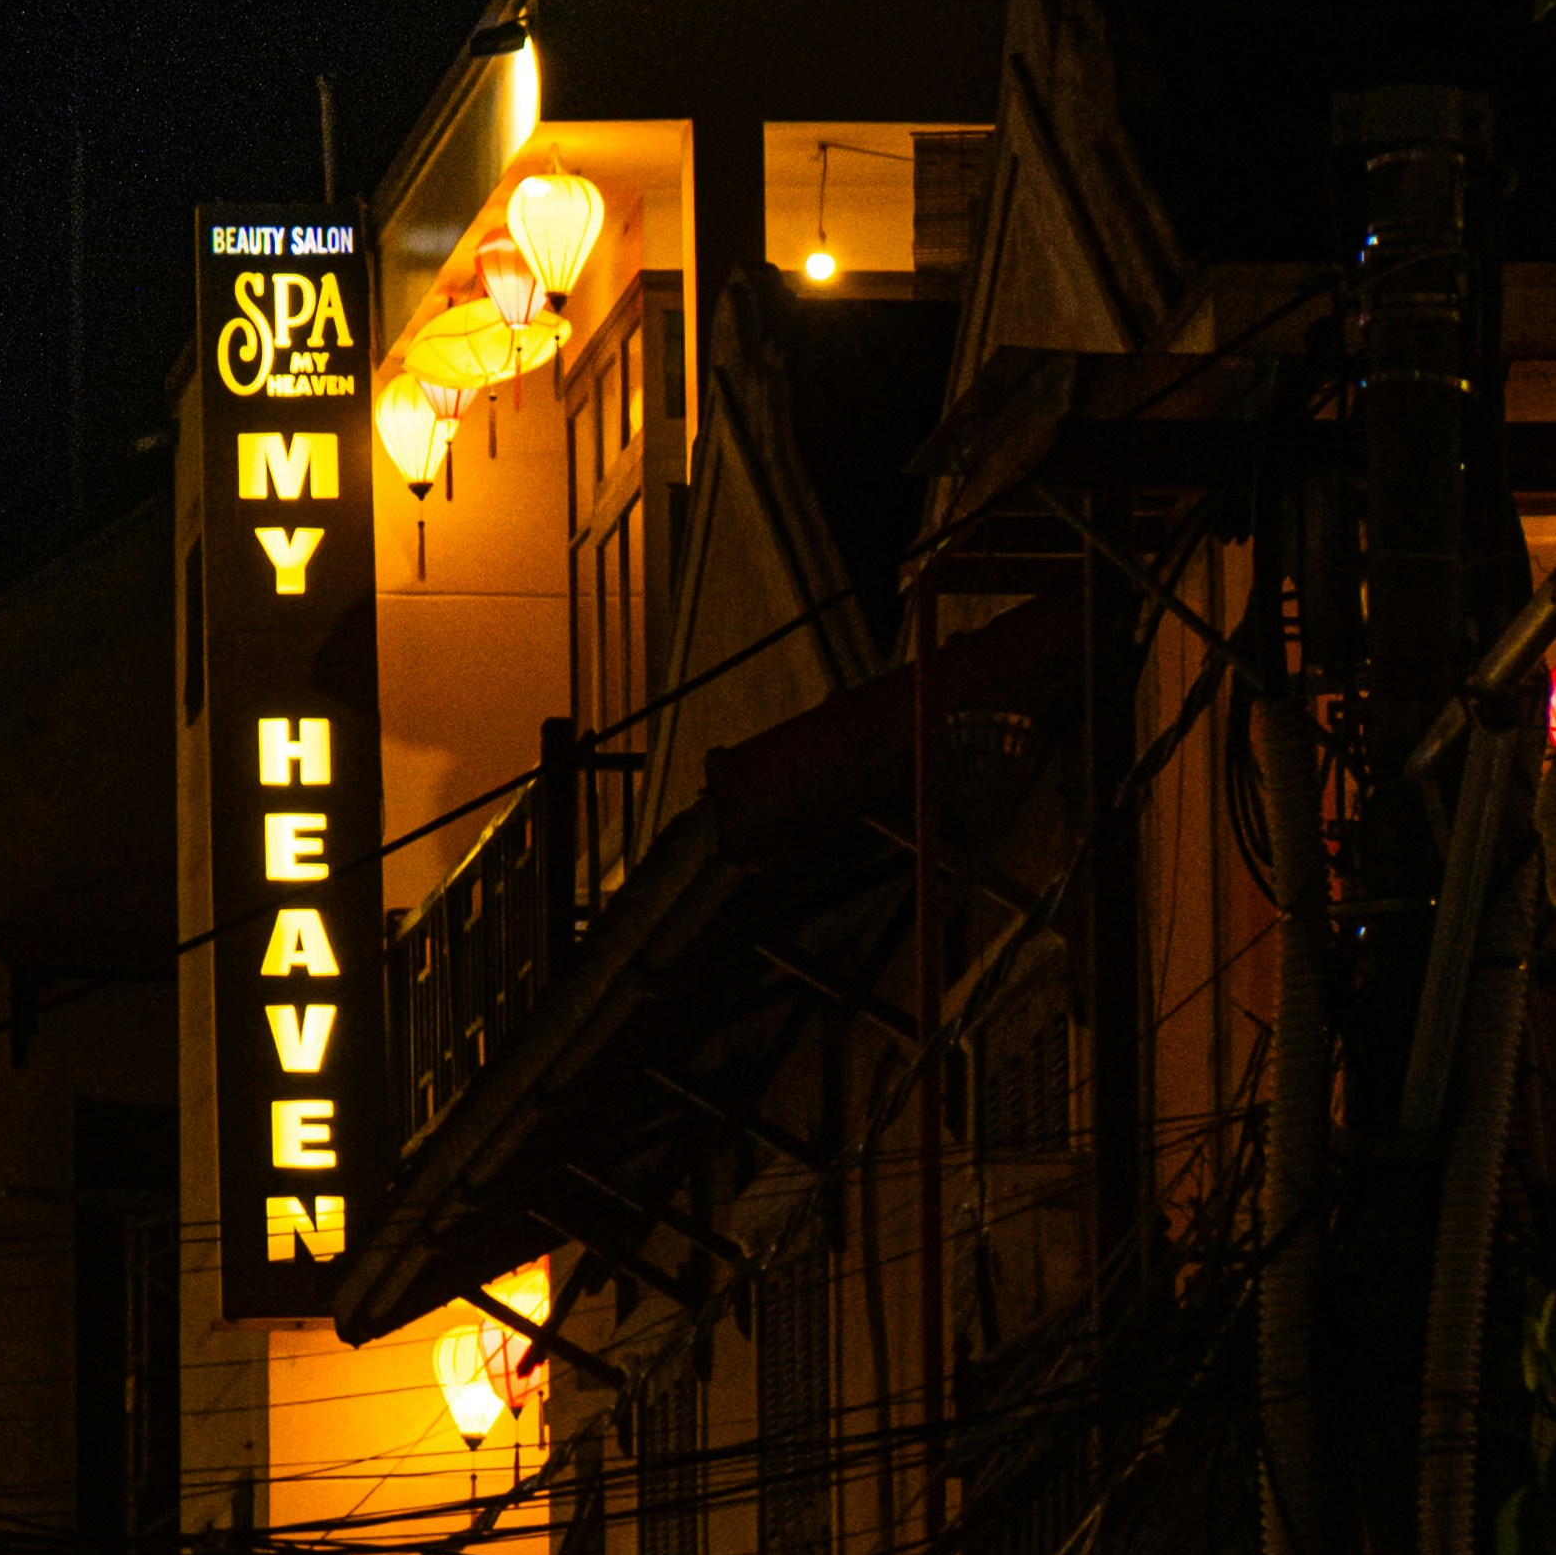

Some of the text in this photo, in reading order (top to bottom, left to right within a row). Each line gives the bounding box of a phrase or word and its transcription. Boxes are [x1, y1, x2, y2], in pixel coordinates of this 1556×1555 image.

[212, 226, 353, 255] BEAUTY SALON
[218, 272, 354, 397] SPA
[290, 351, 330, 374] MY
[266, 375, 355, 397] HEAVEN
[237, 431, 346, 1263] MY HEAVEN
